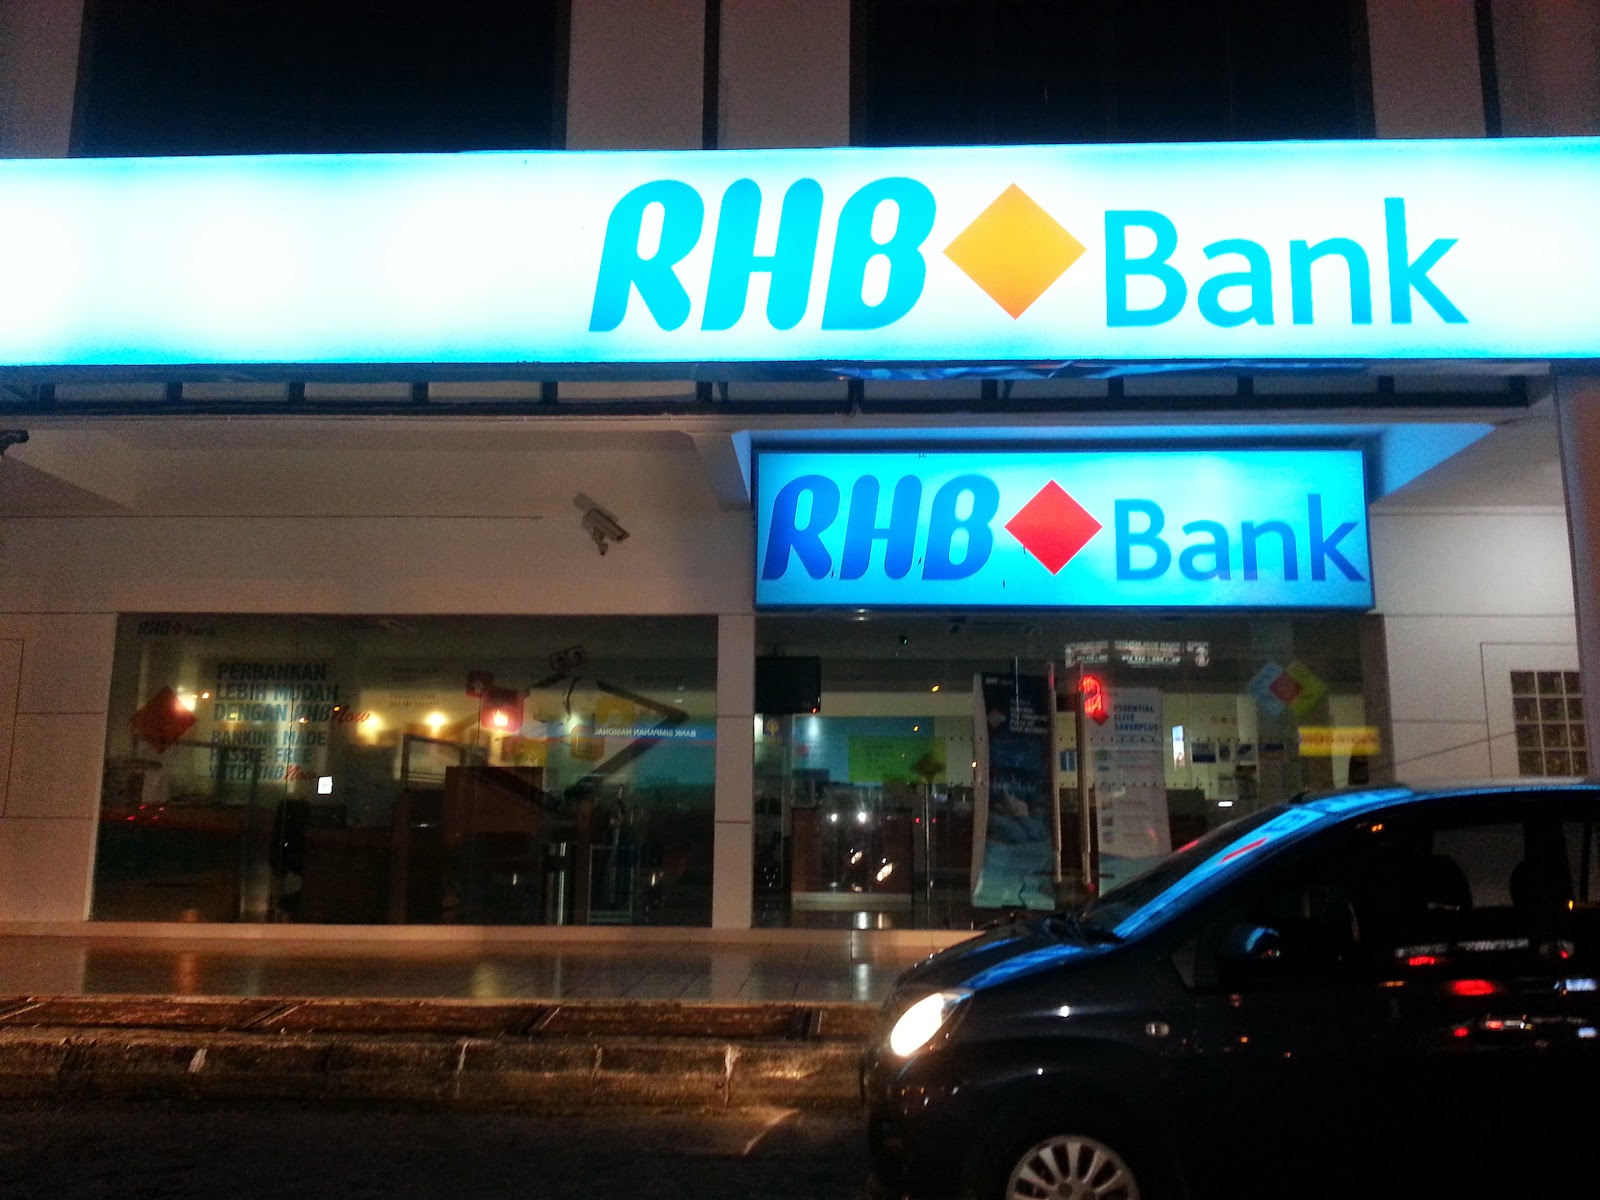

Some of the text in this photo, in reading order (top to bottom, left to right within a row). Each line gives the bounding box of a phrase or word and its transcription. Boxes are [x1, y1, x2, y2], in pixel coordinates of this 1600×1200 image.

[589, 177, 1467, 332] RHB Bank
[761, 474, 1367, 583] RHB Bank
[217, 663, 327, 681] PERBANKAN
[215, 683, 340, 701] LEBIH MUDAH
[213, 703, 287, 722] DENGAN
[211, 730, 328, 746] BANKING MADE
